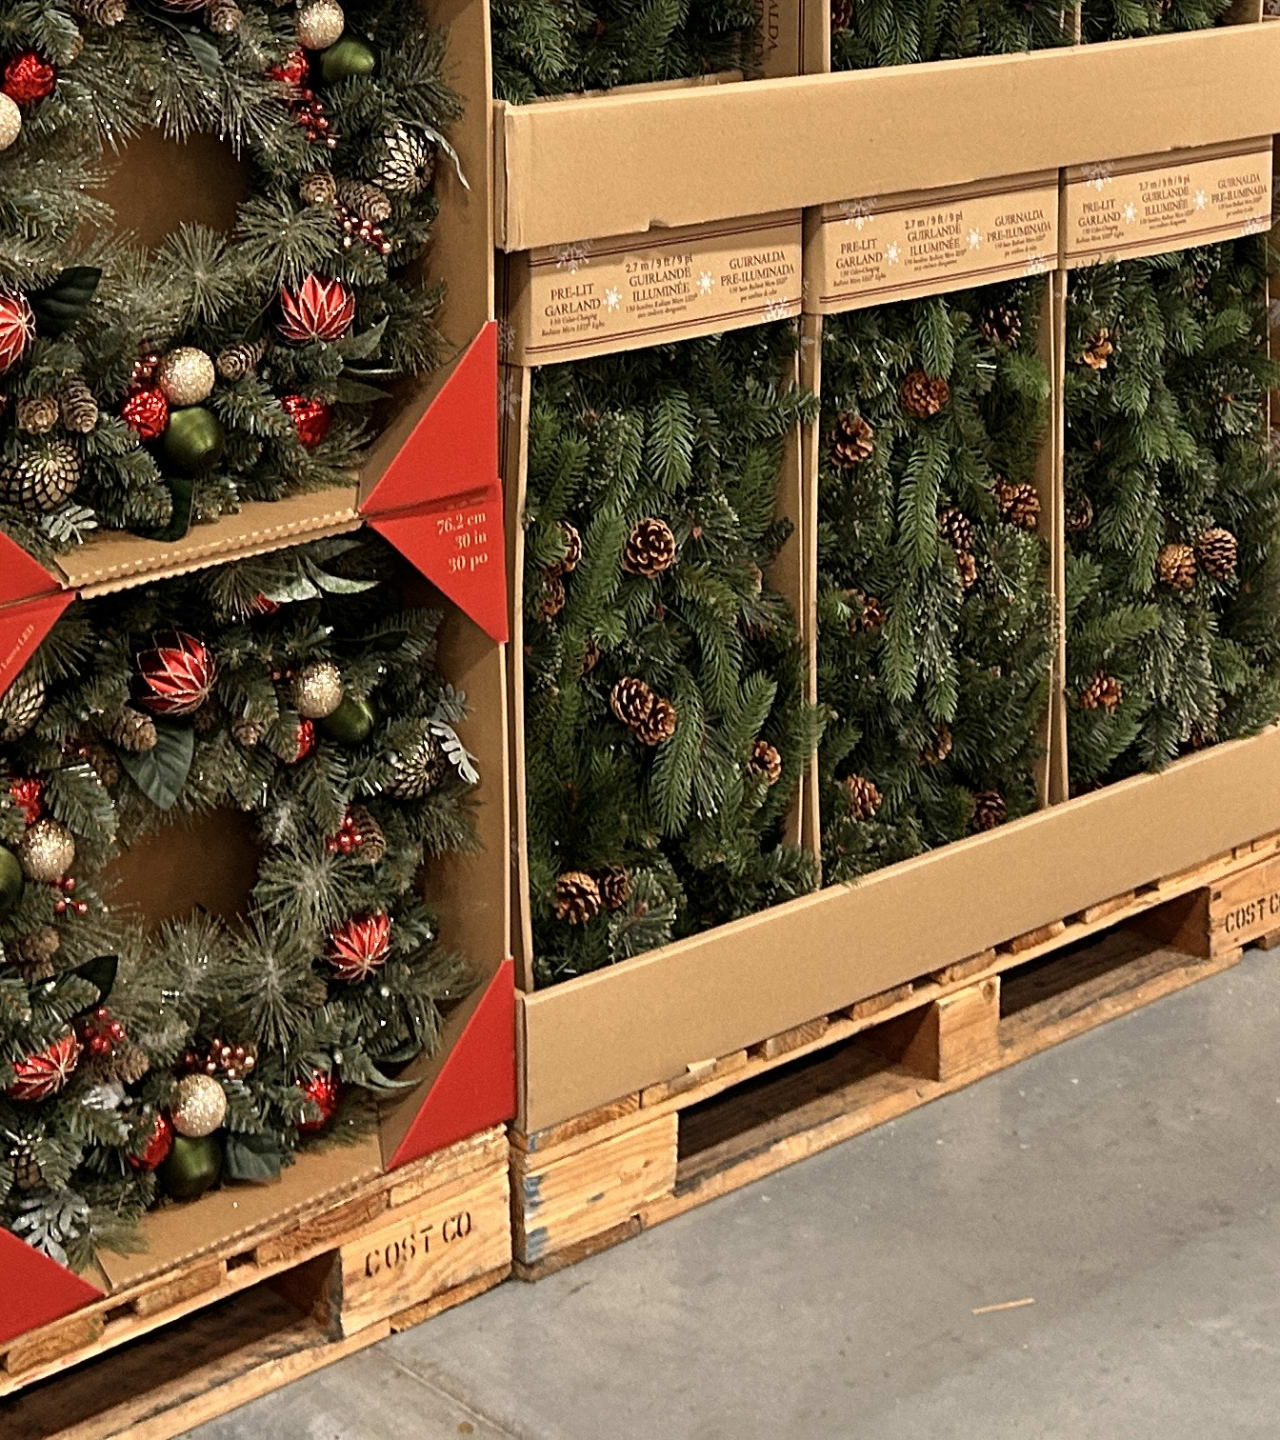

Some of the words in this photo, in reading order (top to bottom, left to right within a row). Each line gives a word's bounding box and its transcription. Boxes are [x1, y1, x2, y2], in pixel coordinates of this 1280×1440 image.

[1217, 174, 1260, 189] GUIRNALDA
[1141, 186, 1189, 203] GUIRLANDE
[1211, 185, 1267, 203] PRE-ILUMINADA
[1082, 199, 1115, 213] PRE-LIT
[994, 210, 1044, 228] GUIRNALDA
[1078, 212, 1121, 228] GARLAND
[907, 225, 962, 243] GUIRLANDE
[987, 222, 1052, 242] PRE-ILUMINADA
[840, 239, 877, 255] PRE-LIT
[910, 238, 961, 257] ILLUMINÉE
[729, 251, 786, 270] GUIRNALDA
[835, 252, 883, 269] GARLAND
[629, 268, 692, 287] GUIRLANDE
[720, 264, 795, 287] PRE-ILUMINADA
[551, 283, 594, 301] PRE-LIT
[632, 282, 690, 302] ILLUMINÉE
[545, 298, 601, 317] GARLAND
[437, 512, 464, 536] 76.2
[467, 513, 486, 526] cm
[455, 532, 471, 550] 30
[474, 530, 487, 545] in
[448, 555, 466, 574] 30
[470, 552, 488, 572] po
